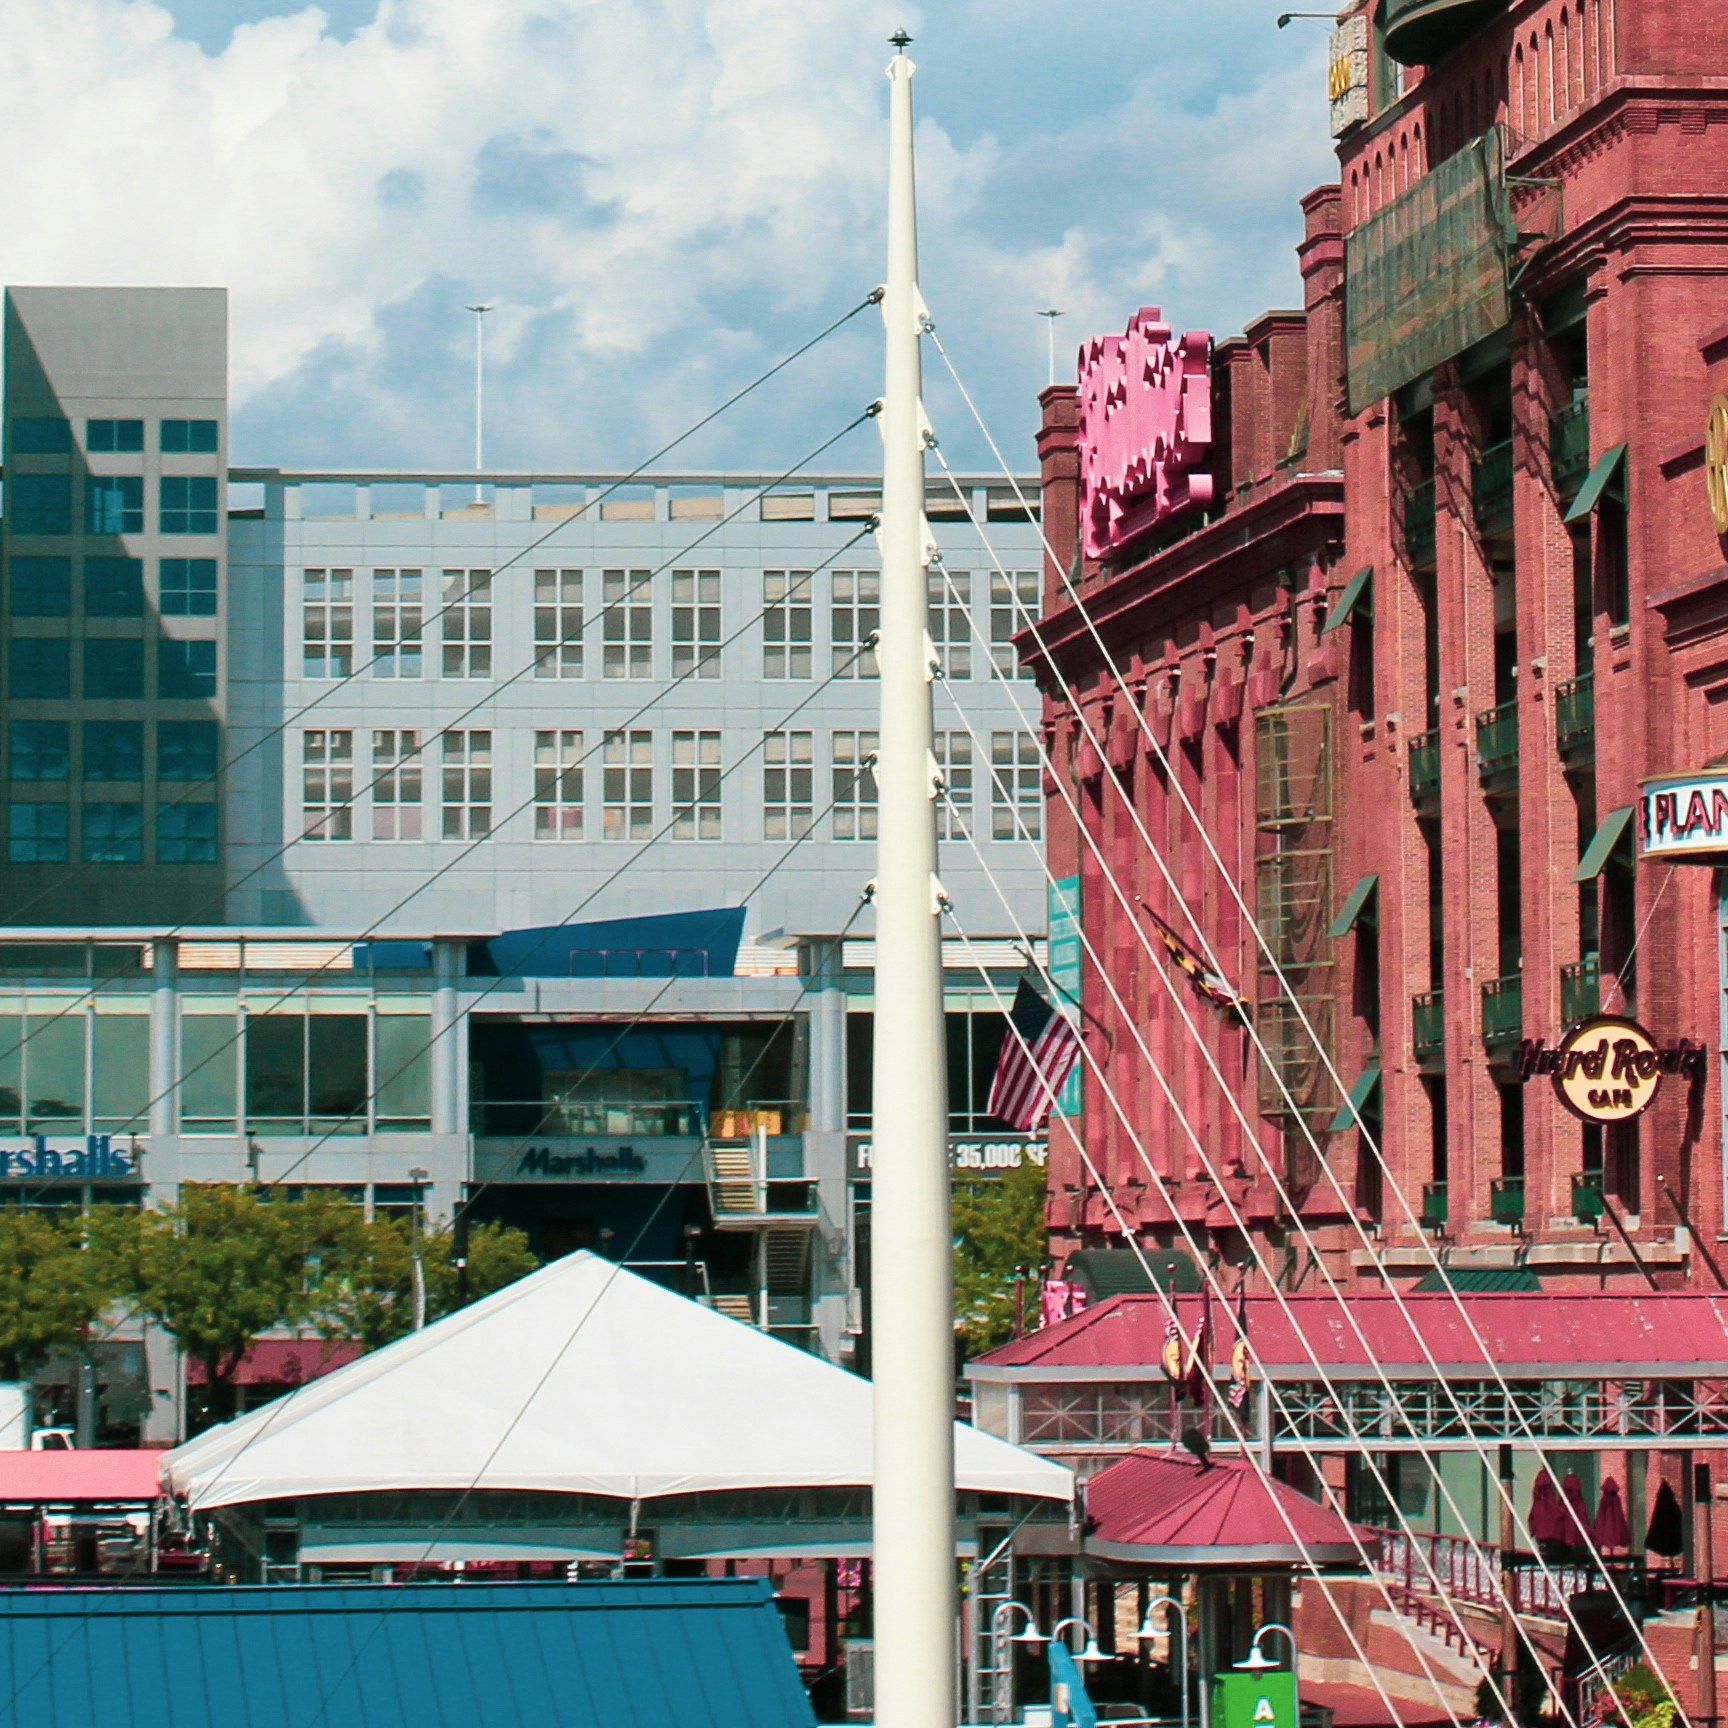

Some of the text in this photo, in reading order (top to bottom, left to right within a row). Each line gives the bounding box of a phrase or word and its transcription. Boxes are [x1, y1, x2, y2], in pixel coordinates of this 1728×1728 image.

[1517, 1038, 1702, 1088] Hard Rock
[1587, 1089, 1633, 1109] CAFE
[516, 1146, 647, 1175] Marshalls
[1254, 1696, 1275, 1721] A
